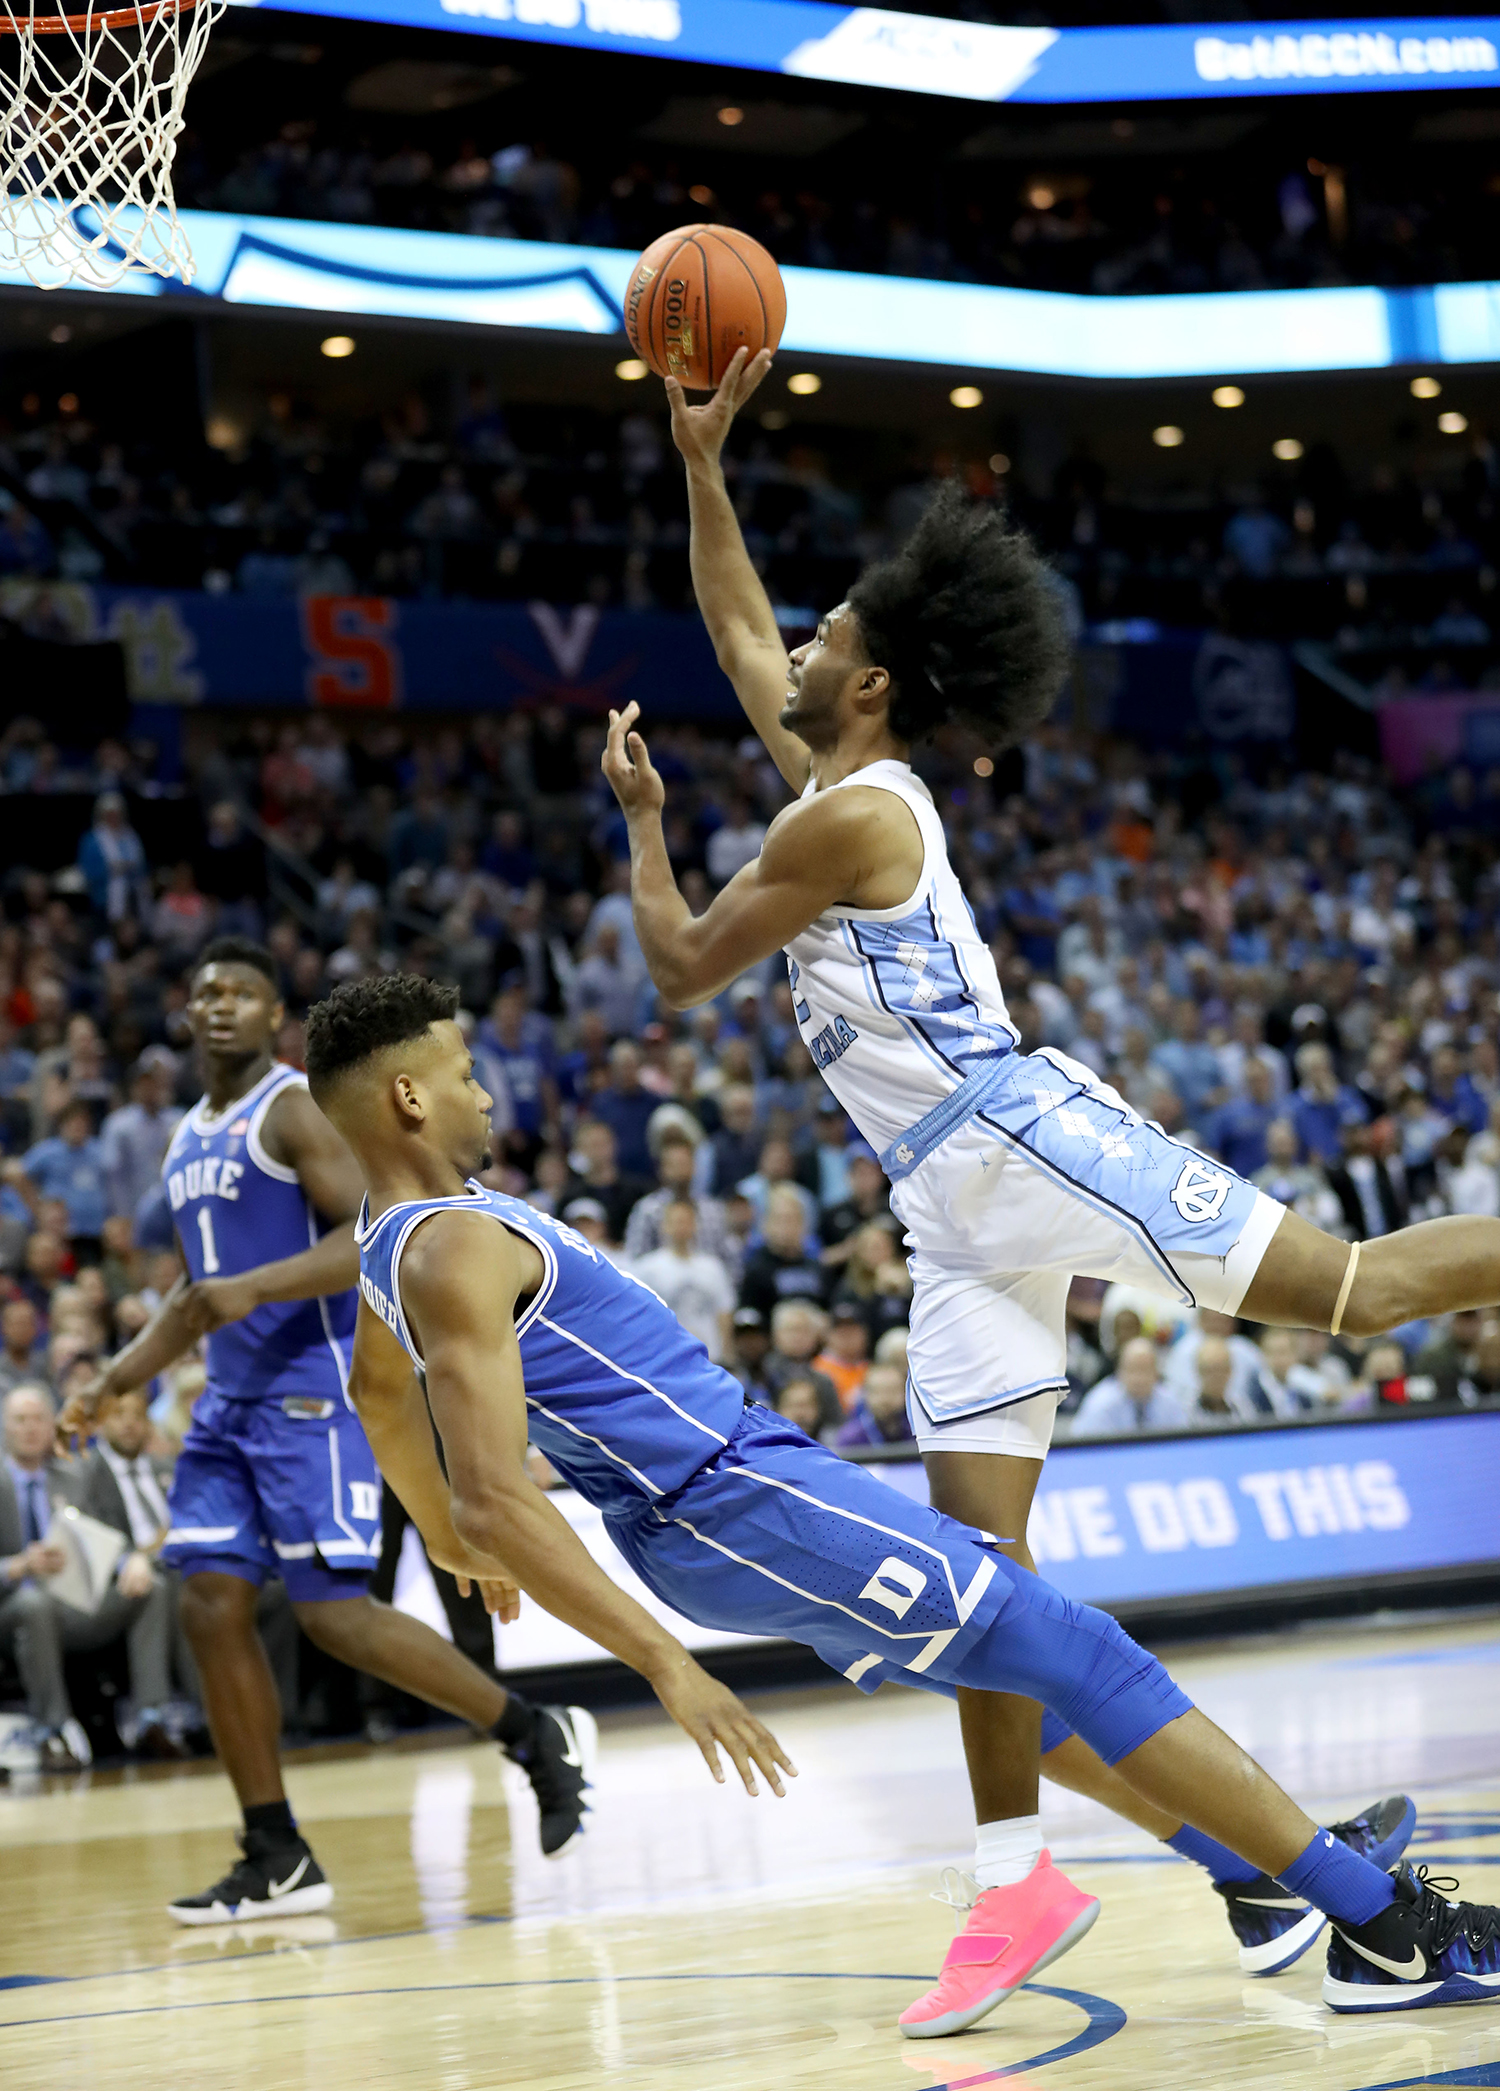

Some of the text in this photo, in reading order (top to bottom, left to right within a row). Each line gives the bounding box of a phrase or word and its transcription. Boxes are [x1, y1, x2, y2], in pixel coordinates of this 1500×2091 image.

[302, 594, 398, 707] S
[527, 599, 601, 678] V
[167, 1156, 245, 1212] DUKE
[197, 1205, 220, 1274] 1
[1125, 1475, 1239, 1553] DO
[1239, 1460, 1411, 1541] THIS
[857, 1556, 928, 1621] D
